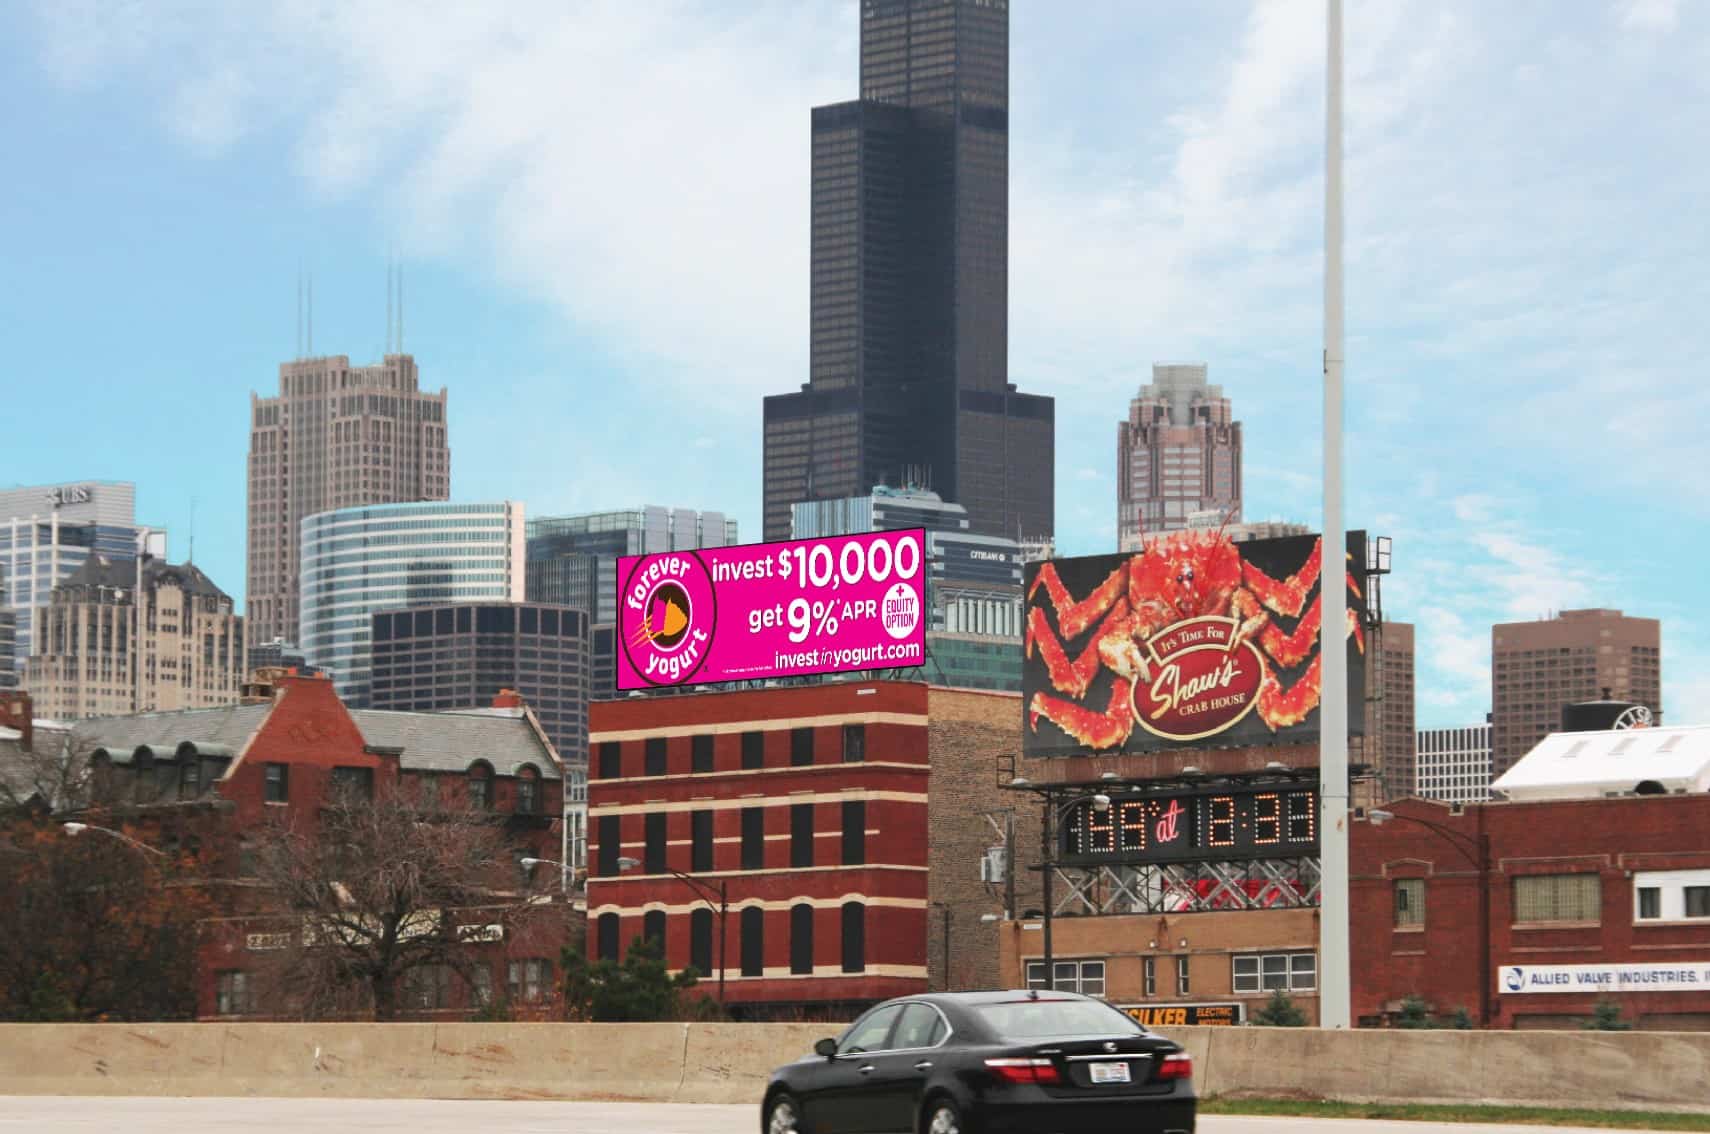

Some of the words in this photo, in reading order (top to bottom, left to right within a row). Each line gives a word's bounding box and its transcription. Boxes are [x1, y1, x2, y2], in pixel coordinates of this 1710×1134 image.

[61, 486, 91, 504] UBS
[712, 555, 774, 582] invest
[778, 536, 920, 590] $10,000
[627, 557, 691, 610] forever
[749, 603, 784, 633] get
[841, 600, 877, 621] APR
[886, 597, 915, 613] EQUITY
[886, 613, 915, 629] OPTION
[645, 628, 708, 680] yogurt
[1150, 655, 1242, 720] Shaw's
[1179, 702, 1209, 716] CRAB
[1211, 693, 1246, 709] HOUSE
[1155, 799, 1185, 843] at
[1531, 972, 1570, 985] ALLIED
[1577, 971, 1613, 984] VALVE
